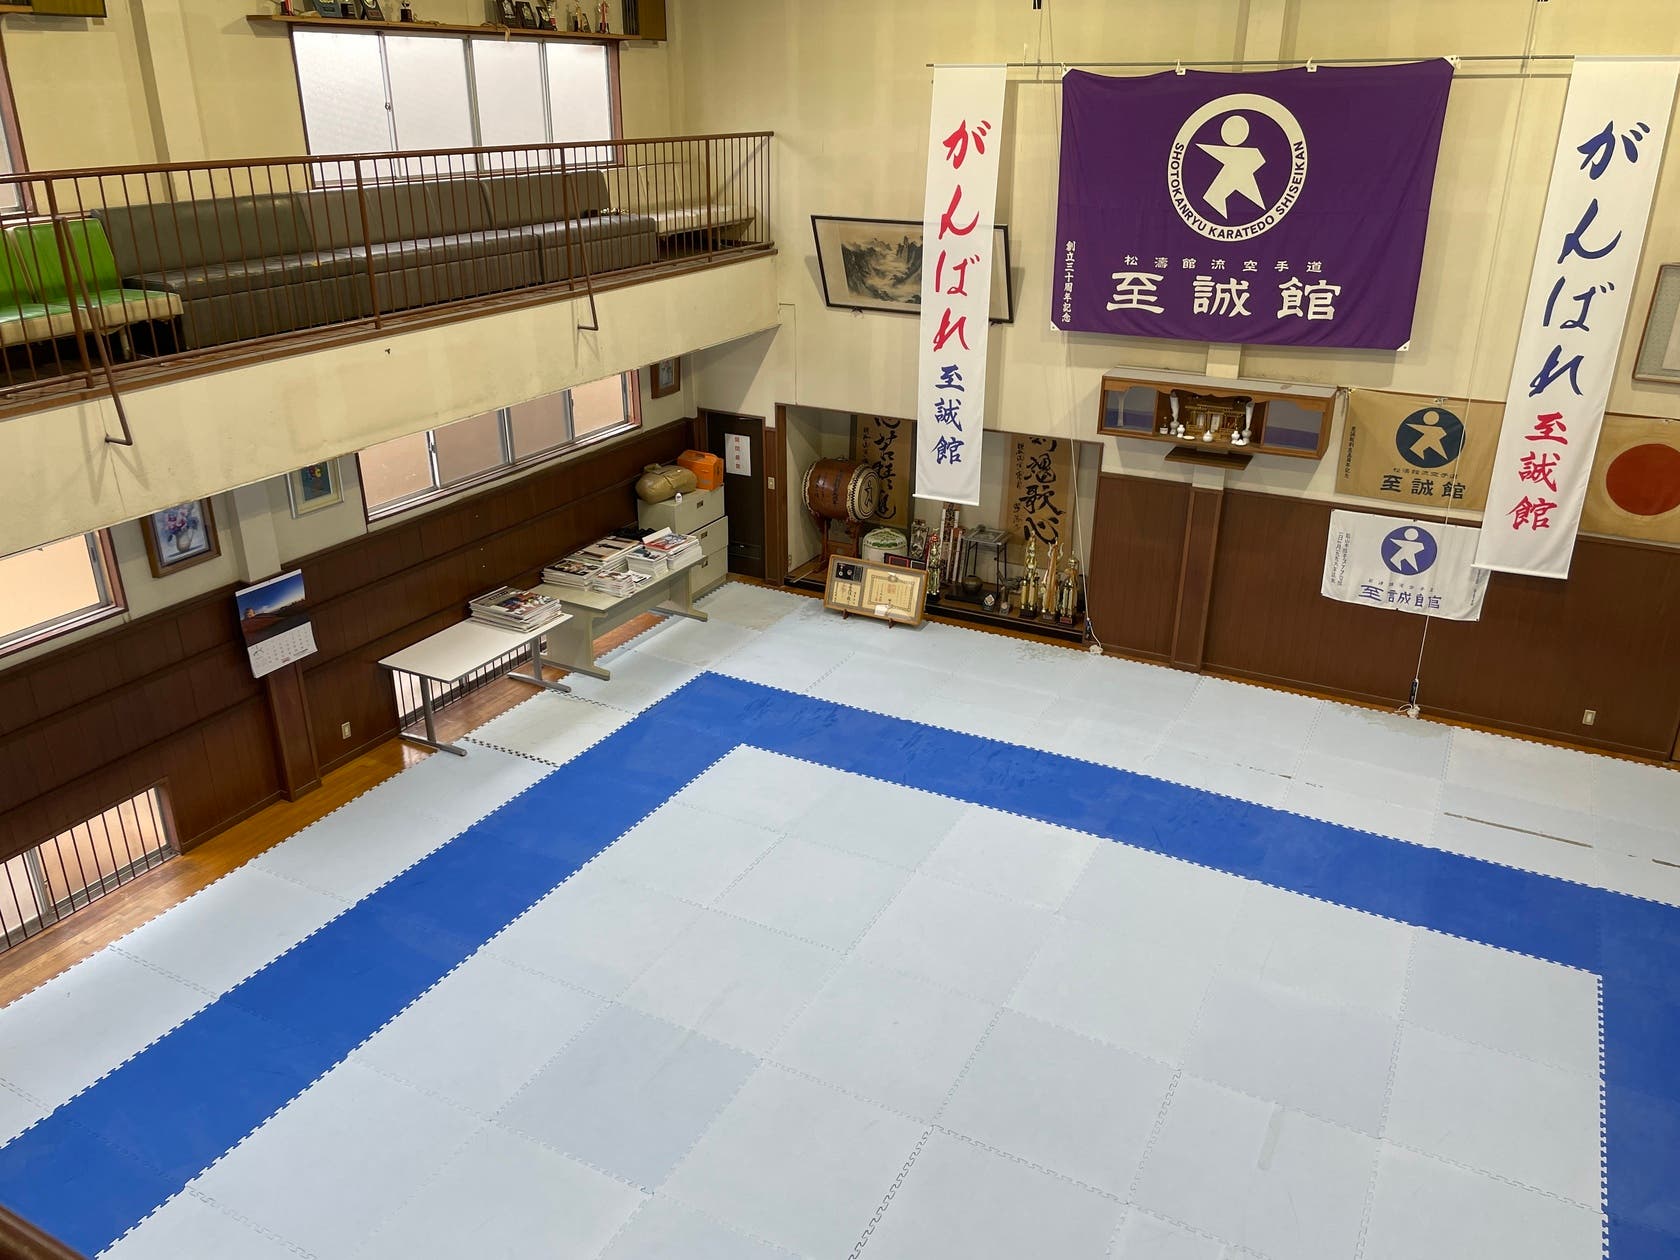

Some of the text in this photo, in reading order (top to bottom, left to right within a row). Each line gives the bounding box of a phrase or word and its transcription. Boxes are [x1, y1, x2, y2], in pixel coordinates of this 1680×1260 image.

[1170, 141, 1305, 240] SHOTOKANRYU KARATEDO SHISEIKAN
[1061, 240, 1077, 323] 創立三十周年記念
[1123, 254, 1323, 273] 松濤館流空手道
[1106, 271, 1342, 321] 至誠館
[1379, 473, 1467, 500] 至誠館
[1358, 583, 1442, 610] 至誠館
